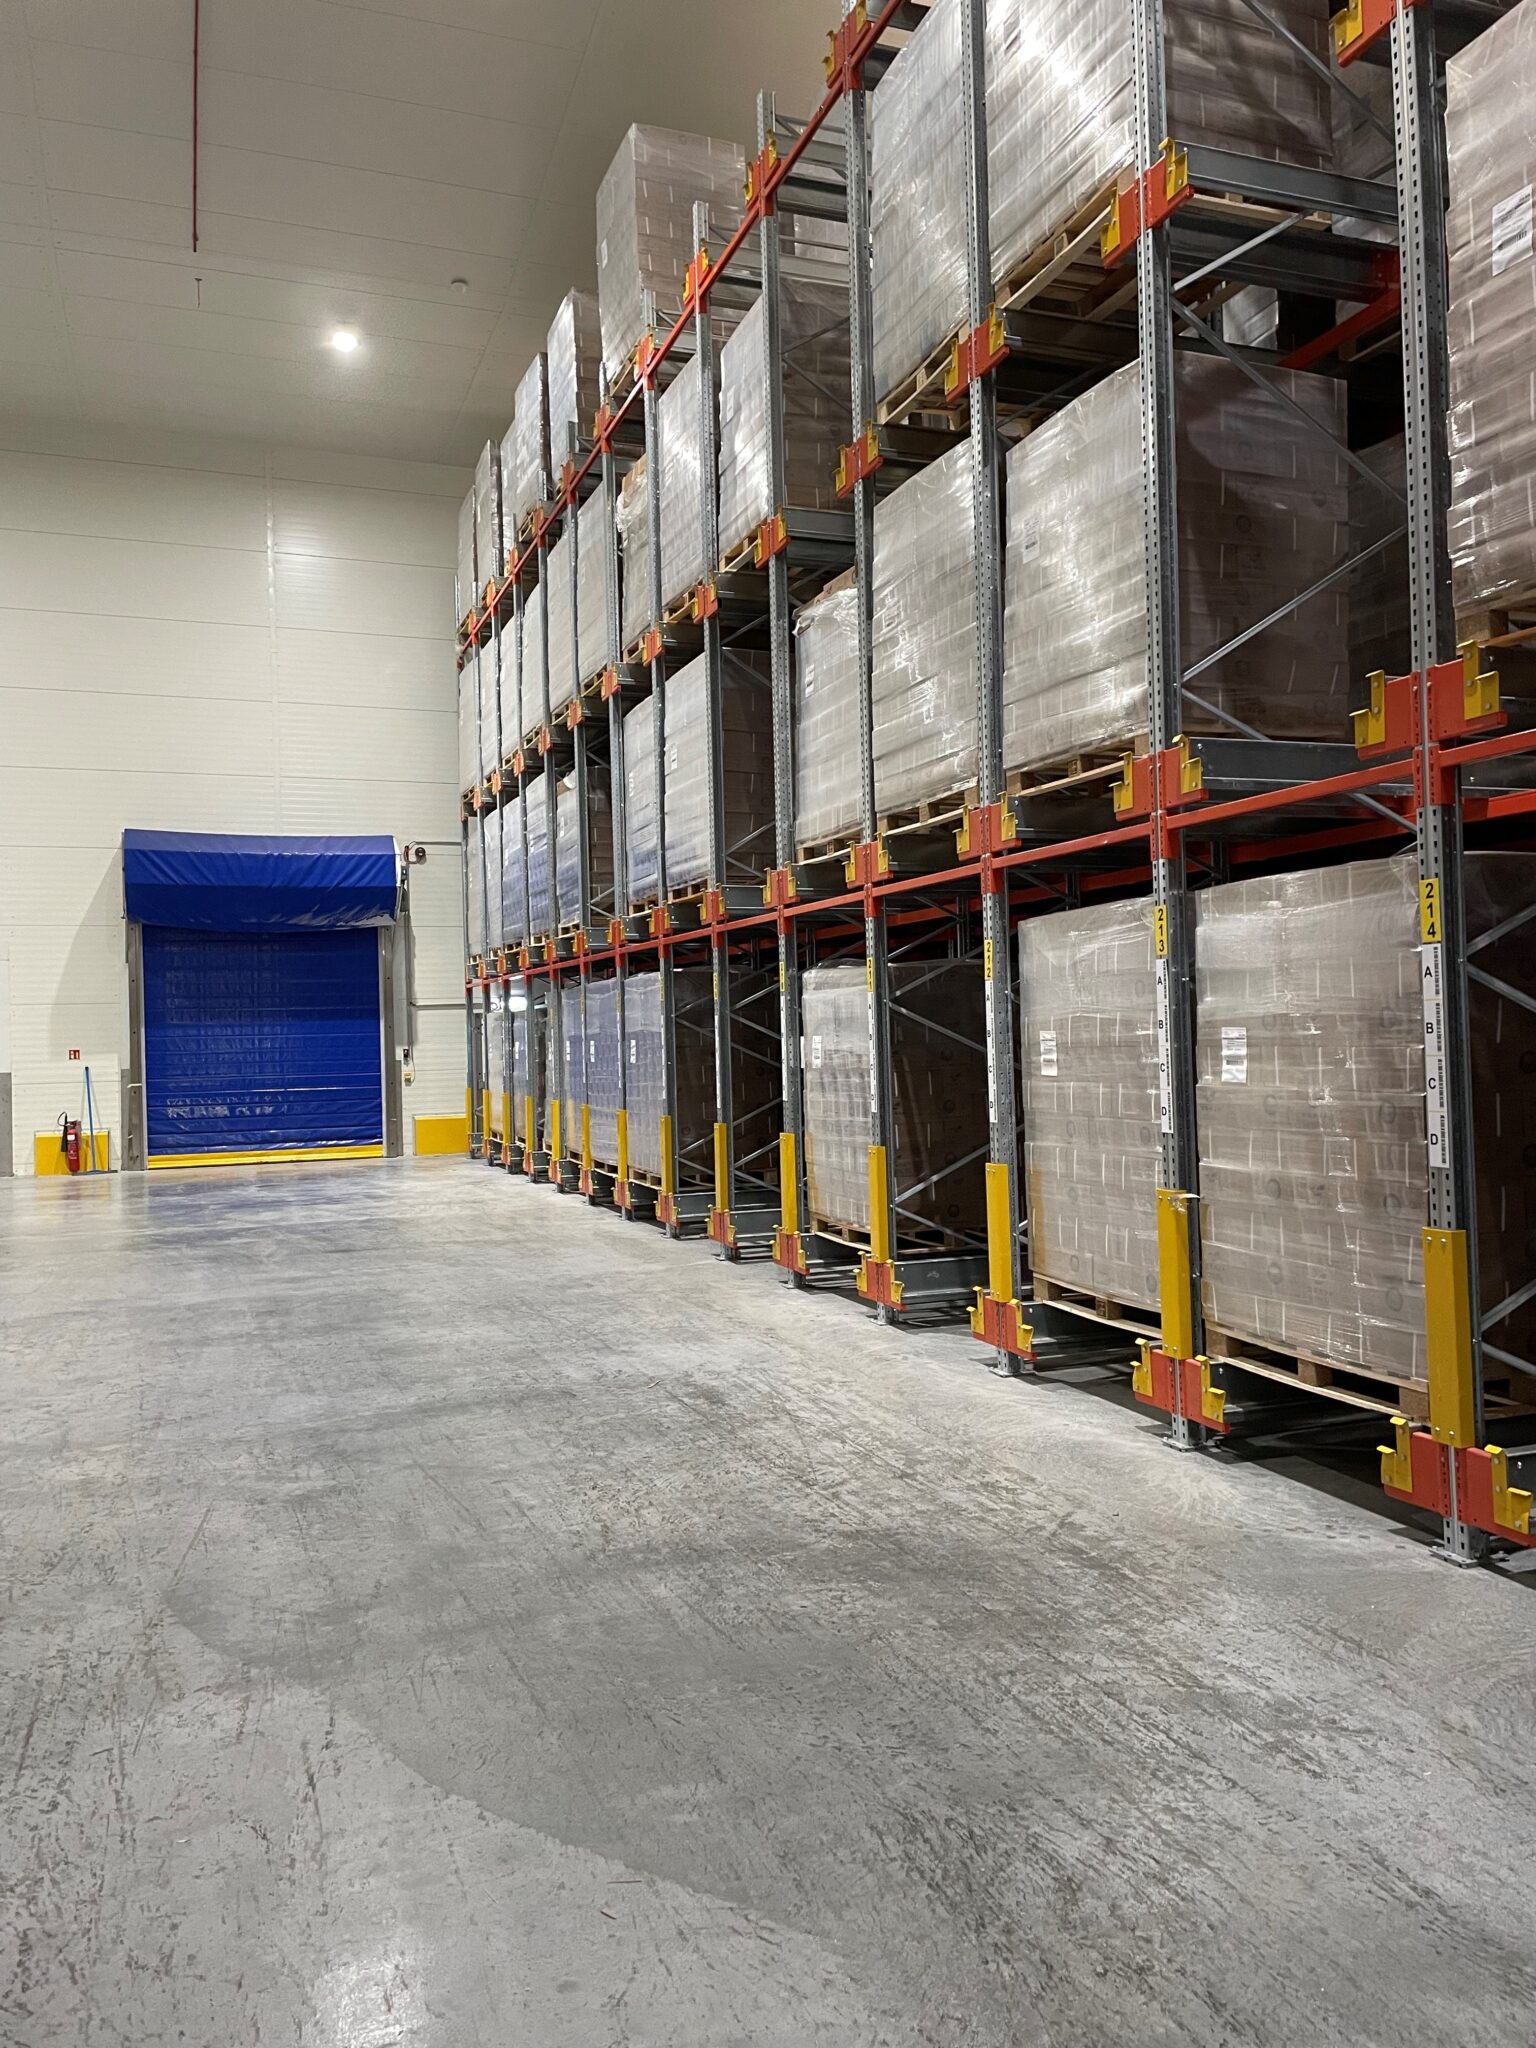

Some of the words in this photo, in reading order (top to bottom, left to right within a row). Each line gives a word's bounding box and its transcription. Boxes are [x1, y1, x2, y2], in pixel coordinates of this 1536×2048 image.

[1424, 882, 1437, 938] 214
[1157, 908, 1165, 952] 213
[1423, 966, 1433, 978] A
[1156, 976, 1163, 985] A
[1158, 1019, 1164, 1029] B
[1426, 1022, 1434, 1034] B
[1160, 1063, 1166, 1072] C
[1427, 1077, 1436, 1089] C
[1161, 1106, 1167, 1116] D
[1430, 1133, 1438, 1145] D
